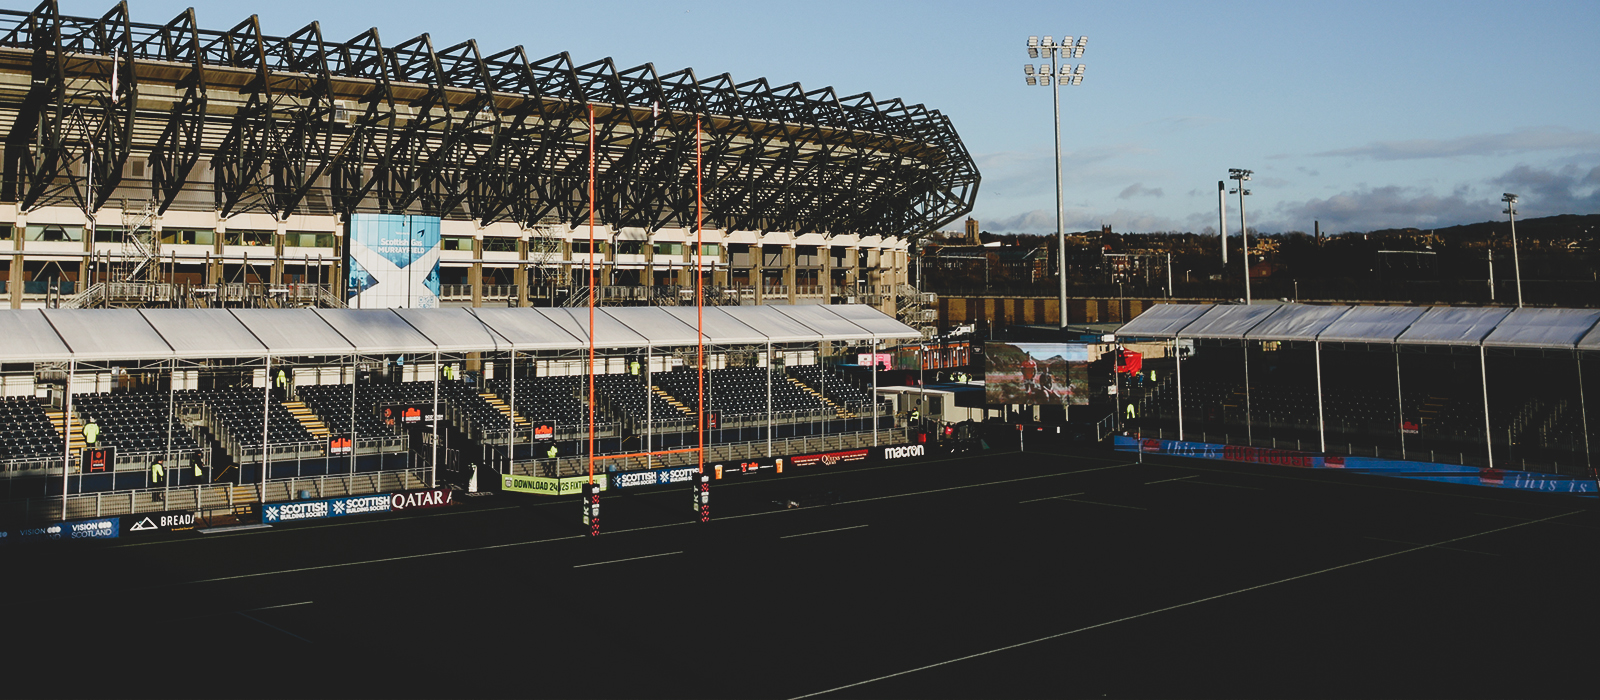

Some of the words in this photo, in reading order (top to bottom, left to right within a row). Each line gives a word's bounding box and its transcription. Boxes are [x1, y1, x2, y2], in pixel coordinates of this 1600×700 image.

[411, 239, 423, 247] Gas
[885, 445, 925, 460] macron
[1167, 441, 1196, 456] this
[1203, 444, 1216, 458] is
[1224, 446, 1254, 462] OUR
[1258, 449, 1313, 467] HOUSE
[622, 471, 657, 483] SCOTTISH
[1515, 473, 1557, 491] this
[1569, 478, 1588, 493] is
[513, 479, 548, 491] DOWNLOAD
[346, 496, 390, 509] SCOTTISH
[391, 490, 443, 509] QATAR
[280, 501, 328, 515] SCOTTISH
[280, 512, 305, 520] BUILDING
[20, 528, 46, 536] VISION
[72, 522, 98, 532] VISION
[71, 529, 112, 539] SCOTLAND
